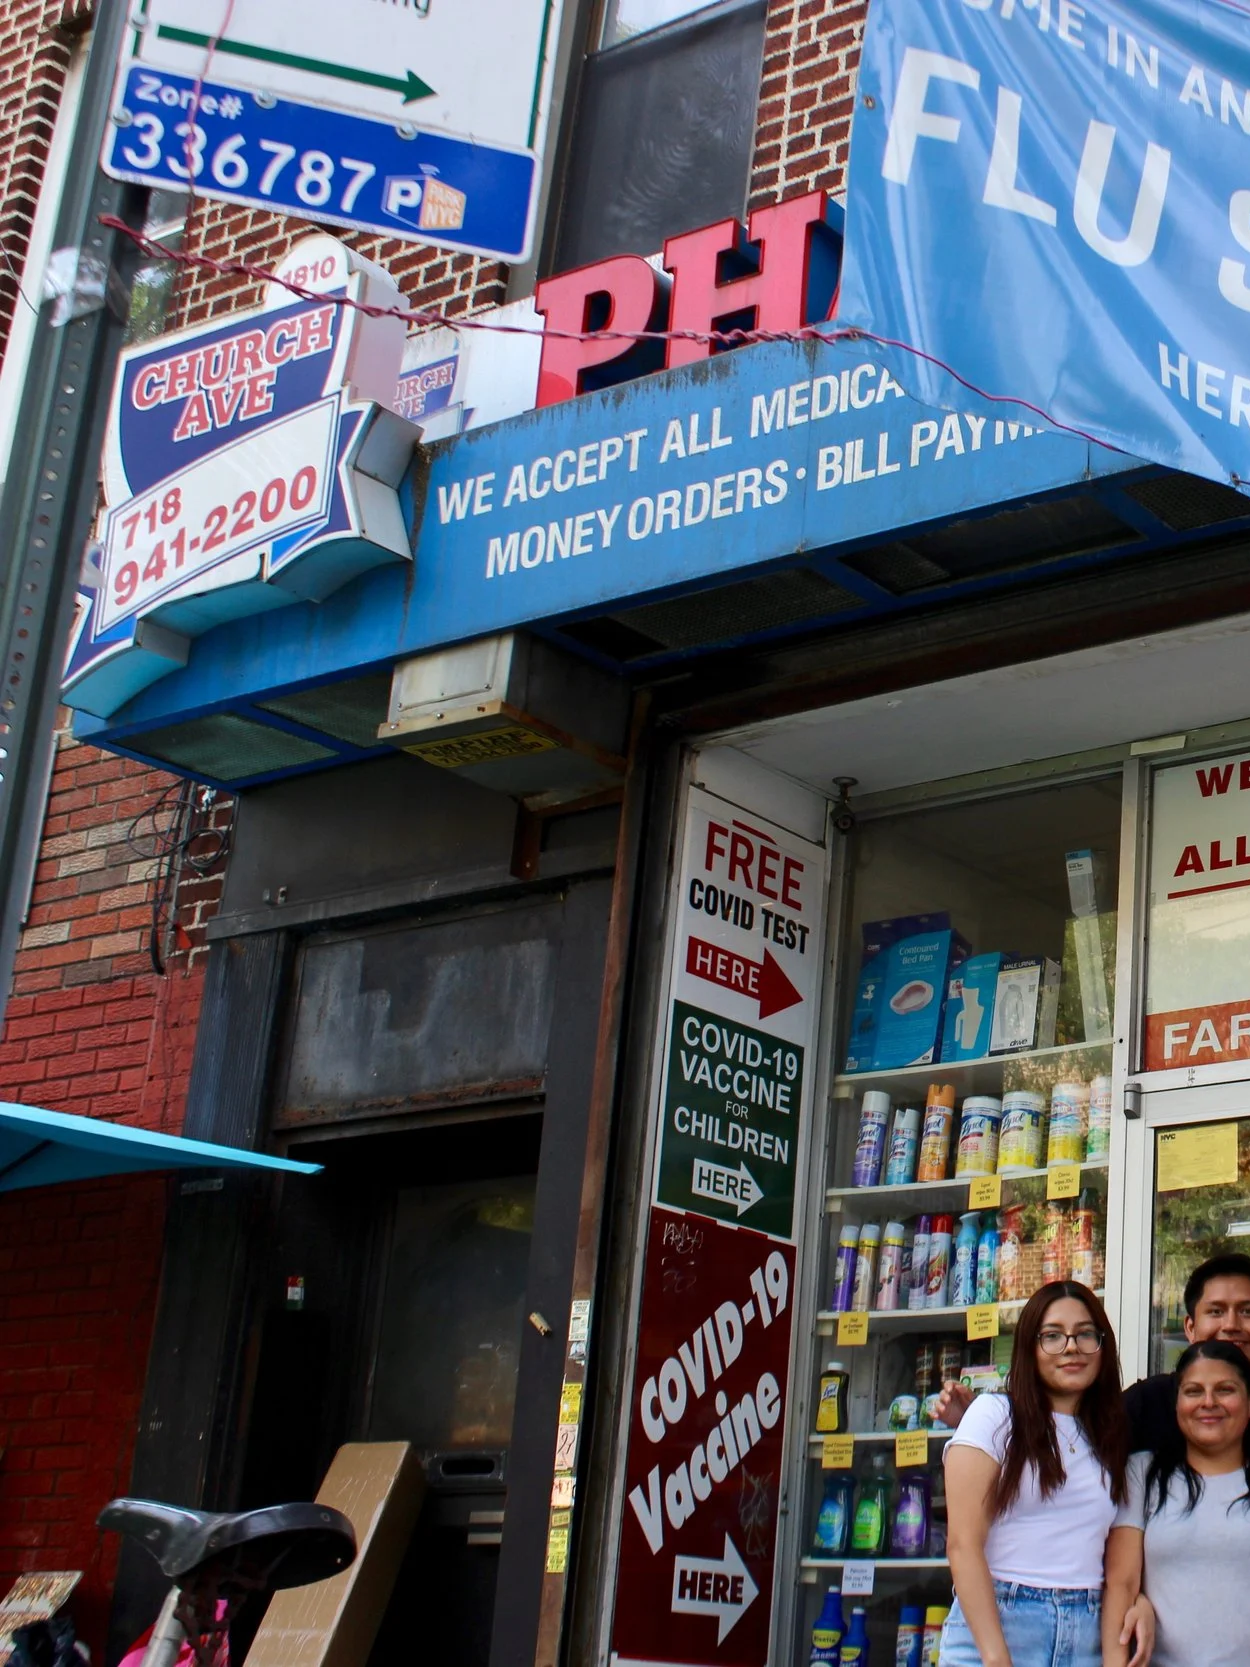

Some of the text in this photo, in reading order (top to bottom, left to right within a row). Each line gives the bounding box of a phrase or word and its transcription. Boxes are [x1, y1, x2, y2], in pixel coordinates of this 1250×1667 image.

[1106, 26, 1160, 90] IN
[134, 73, 245, 121] Zone#
[122, 112, 378, 214] 336787
[881, 46, 1172, 268] FLU
[425, 203, 463, 228] NYC
[427, 182, 464, 207] PARK
[282, 255, 337, 289] 1810
[132, 306, 336, 413] CHURCH
[173, 371, 278, 442] AVE
[437, 362, 906, 525] WE ACCEPT ALL MEDICA
[114, 465, 317, 606] 941-2200
[120, 487, 182, 551] 718
[485, 503, 623, 580] MONEY
[627, 458, 789, 542] ORDERS
[816, 433, 901, 491] BILL
[704, 820, 805, 912] FREE
[688, 878, 811, 956] COVID TEST
[899, 942, 940, 956] Contoured
[694, 944, 762, 996] HERE
[902, 953, 934, 965] Bed Pan
[1003, 961, 1018, 970] MALE
[681, 1015, 799, 1083] COVID-19
[679, 1048, 792, 1116] VACCINE
[724, 1099, 750, 1122] FOR
[673, 1105, 790, 1166] CHILDREN
[698, 1165, 753, 1204] HERE
[639, 1249, 790, 1444] COVID-19
[627, 1371, 782, 1556] Vaccine
[677, 1569, 746, 1606] HERE
